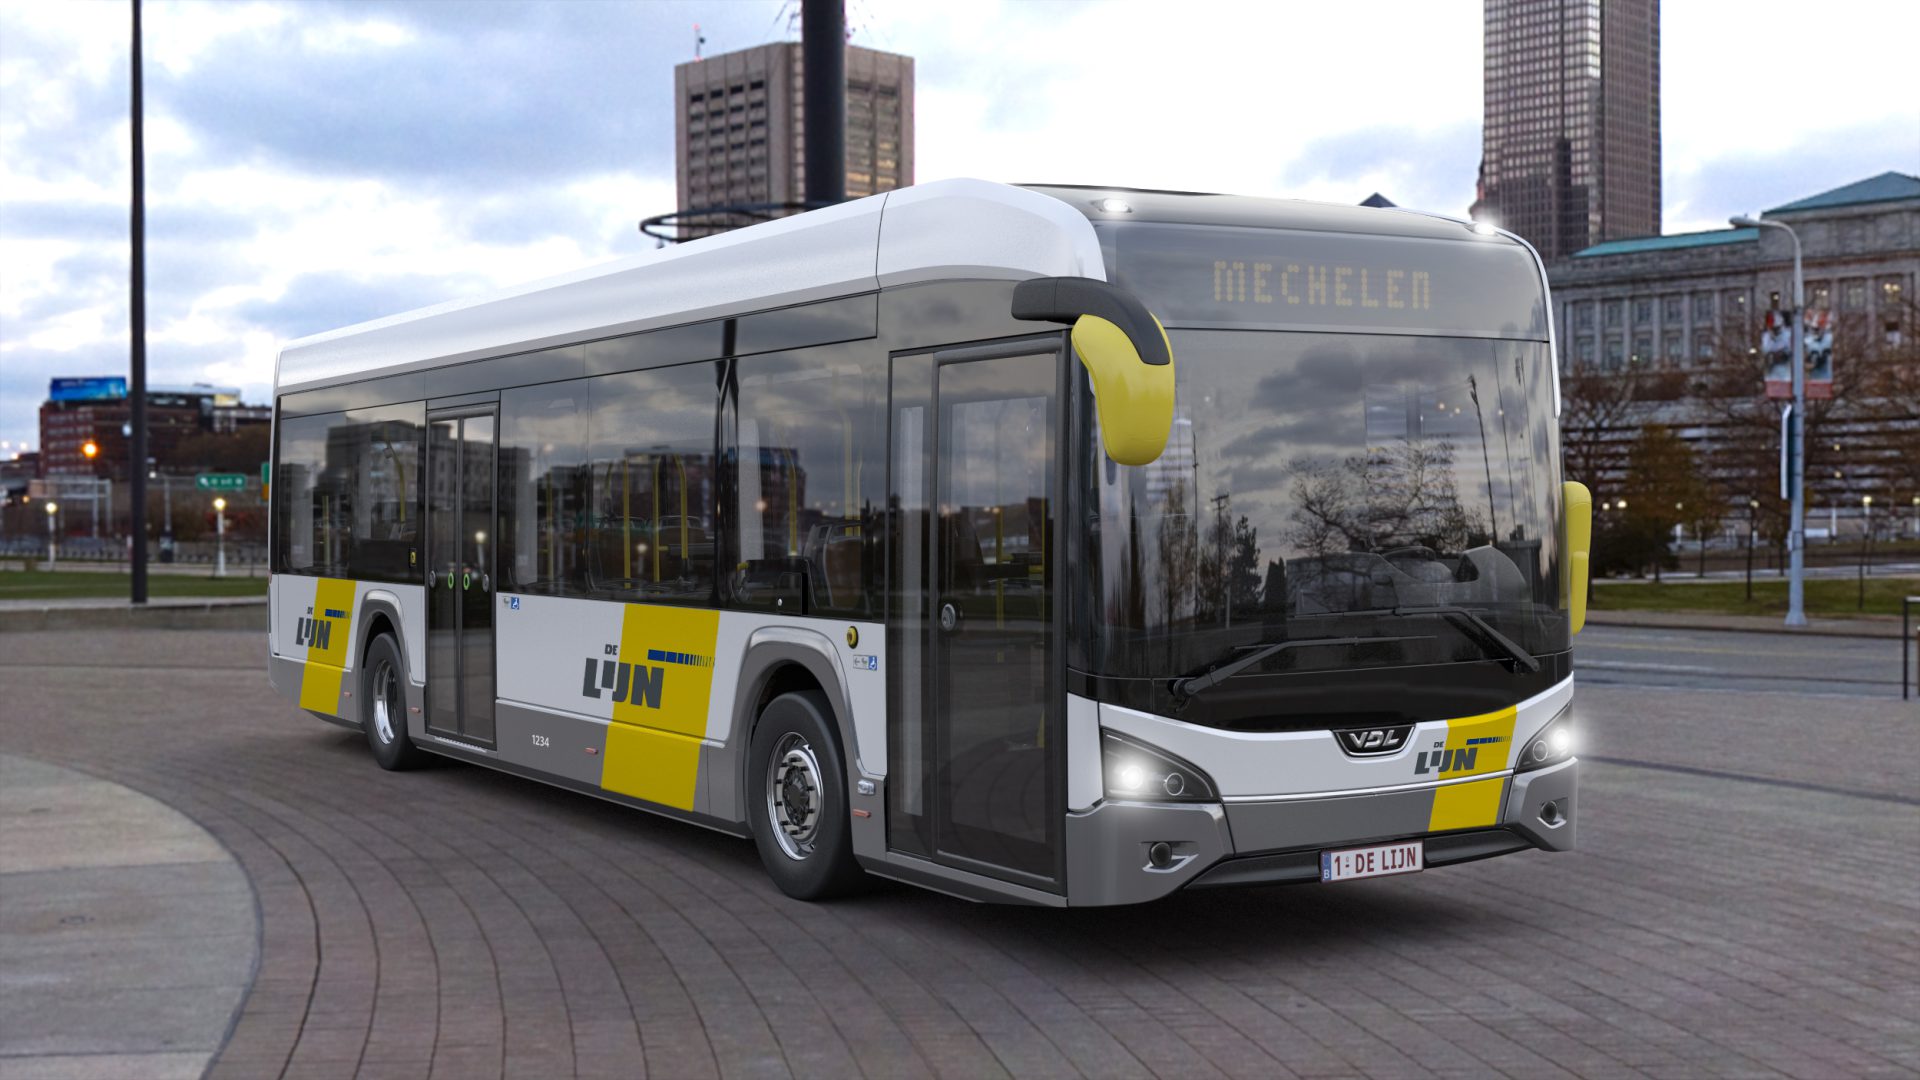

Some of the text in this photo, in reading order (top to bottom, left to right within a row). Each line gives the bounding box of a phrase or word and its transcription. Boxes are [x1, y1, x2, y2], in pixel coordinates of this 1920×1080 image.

[1214, 261, 1430, 309] MECHELEN
[296, 617, 331, 650] LIJN
[604, 644, 619, 655] DE
[583, 658, 664, 709] LIJN
[532, 734, 549, 747] 1234
[1349, 730, 1399, 748] VDL
[1414, 748, 1478, 775] LIJN
[1382, 847, 1416, 870] LIJN
[1323, 869, 1330, 879] B
